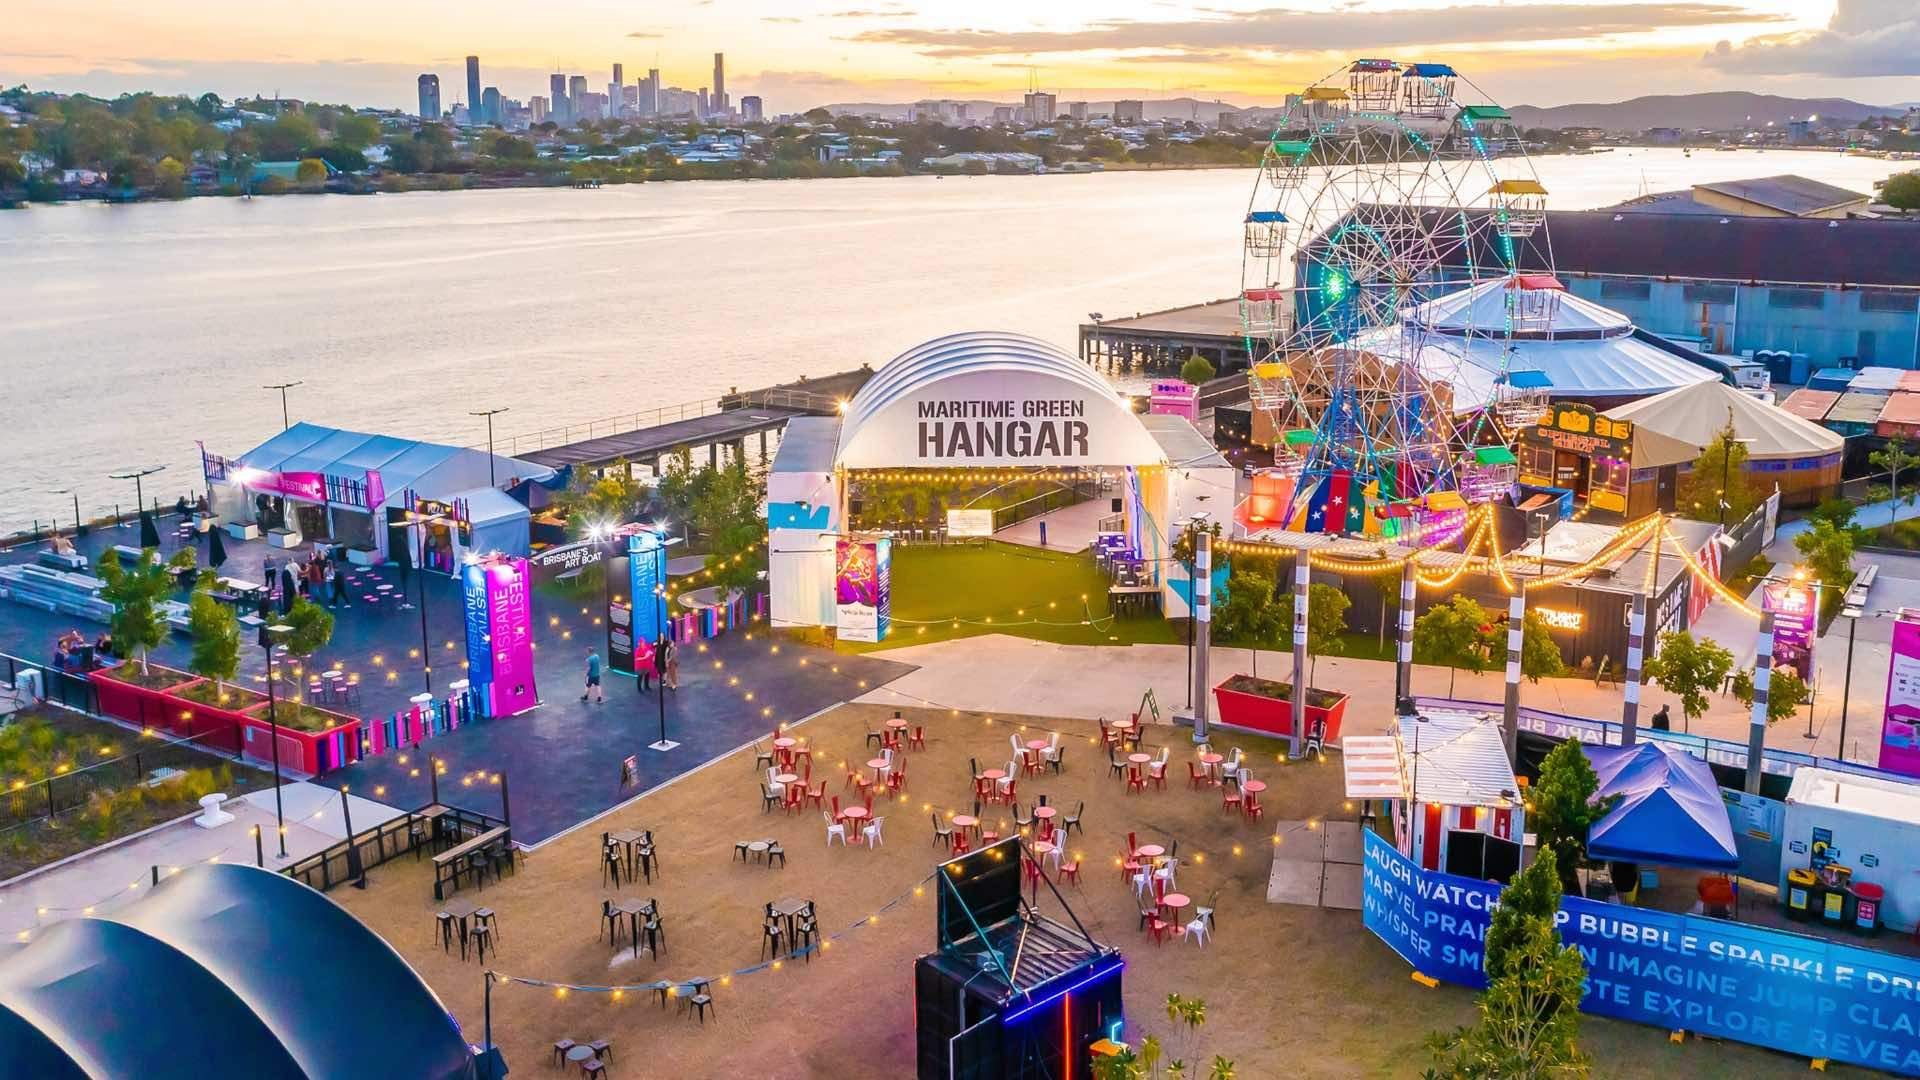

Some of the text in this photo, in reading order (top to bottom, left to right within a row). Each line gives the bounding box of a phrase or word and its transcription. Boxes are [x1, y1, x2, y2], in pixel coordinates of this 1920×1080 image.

[918, 400, 1084, 418] MARITIME GREEN
[918, 420, 1089, 458] HANGAR
[543, 547, 588, 566] BRISBANE'S
[564, 552, 603, 569] ART BOAT
[465, 586, 481, 673] BRISBANE
[474, 575, 491, 655] FESTIVAL
[494, 587, 513, 675] BRISBANE
[509, 570, 527, 648] FESTIVAL
[1363, 835, 1502, 913] LAUGH WATCH
[1363, 866, 1485, 942] MARVEL PRAI
[1363, 892, 1431, 959] WHISPER
[1580, 913, 1698, 957] BUBBLE
[1708, 941, 1854, 989] SPARKLE
[1608, 951, 1738, 998] IMAGINE
[1749, 983, 1837, 1016] JUMP
[1848, 1003, 1920, 1037] CLA
[1643, 990, 1792, 1041] EXPLORE
